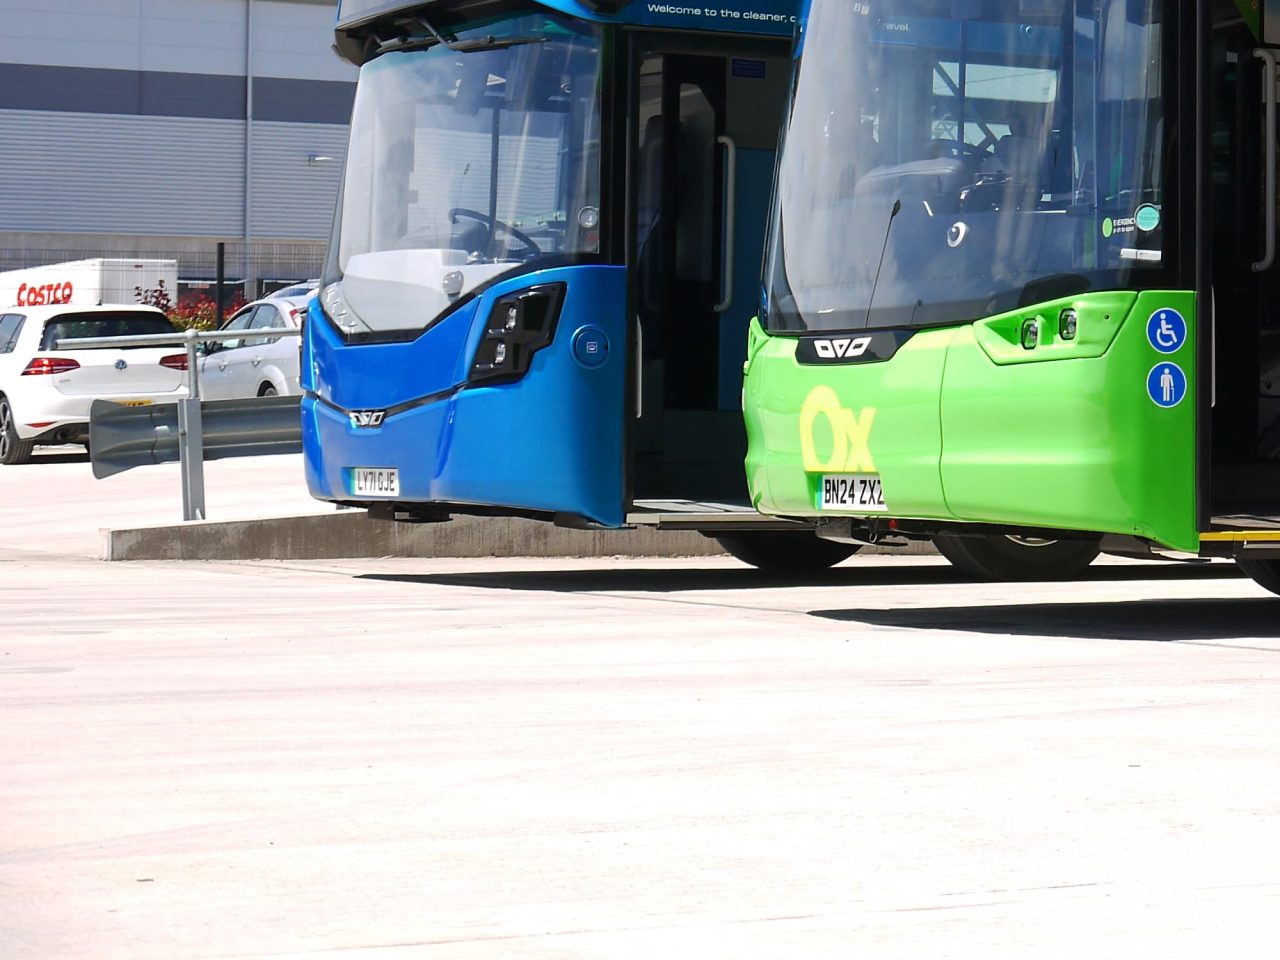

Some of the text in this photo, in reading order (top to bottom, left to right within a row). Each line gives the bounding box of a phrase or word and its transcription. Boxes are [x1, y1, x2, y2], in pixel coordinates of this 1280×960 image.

[648, 3, 701, 16] Welcome
[704, 7, 717, 17] to
[720, 8, 740, 19] the
[743, 11, 787, 24] cleaner,
[17, 281, 73, 307] COSTCO
[800, 384, 876, 473] Ox
[824, 478, 856, 505] BN24
